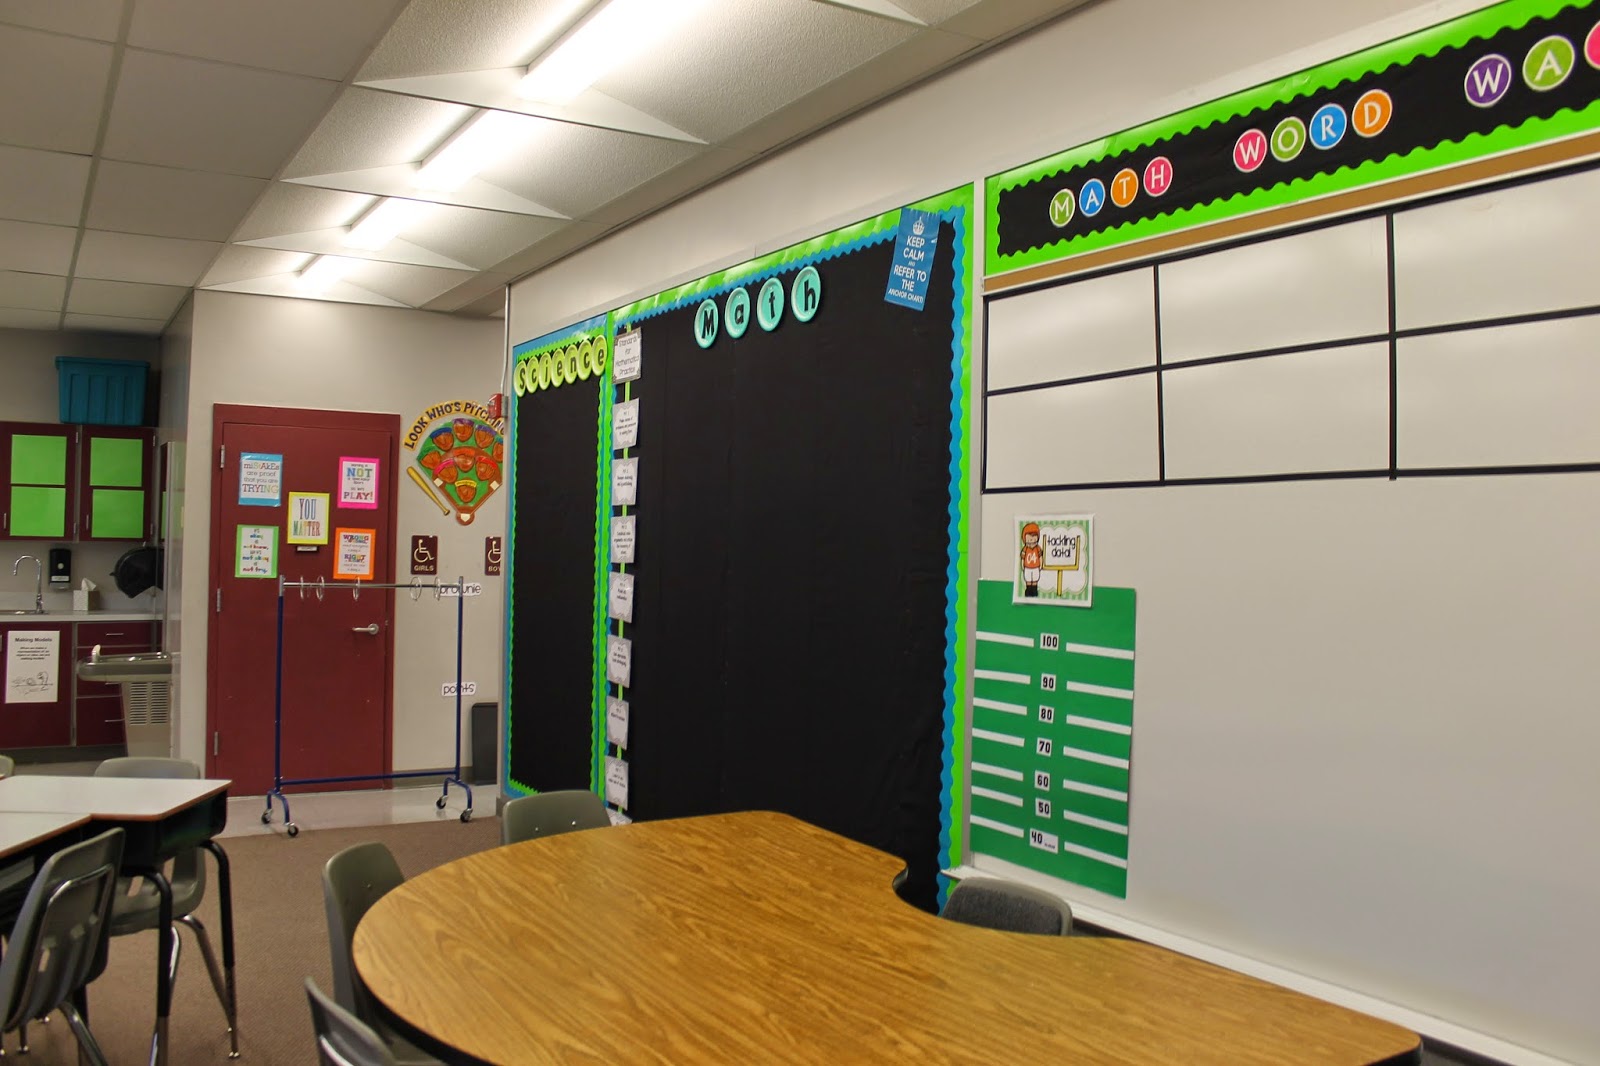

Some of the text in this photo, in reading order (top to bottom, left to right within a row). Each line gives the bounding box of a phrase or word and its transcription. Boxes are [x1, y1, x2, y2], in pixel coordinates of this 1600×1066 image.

[1053, 164, 1166, 219] MATH
[1238, 102, 1382, 166] WORD
[907, 235, 925, 248] KEEP
[903, 247, 925, 261] CALM
[894, 265, 927, 282] REFER TO
[901, 279, 915, 292] THE
[701, 279, 816, 340] Math
[404, 416, 429, 450] LOOK
[425, 402, 461, 421] WHO'S
[347, 467, 373, 478] NOT
[242, 483, 279, 494] TRYING
[343, 491, 374, 501] PLAY!
[299, 498, 317, 520] YOU
[293, 520, 321, 537] MATTER
[414, 564, 434, 572] GIRLS
[1042, 635, 1058, 648] 100
[443, 683, 475, 695] ponts
[1042, 676, 1054, 689] 90
[1041, 708, 1053, 721] 80
[1039, 740, 1051, 754] 70
[1037, 774, 1049, 788] 60
[1038, 801, 1050, 815] 50
[1031, 830, 1043, 844] 40
